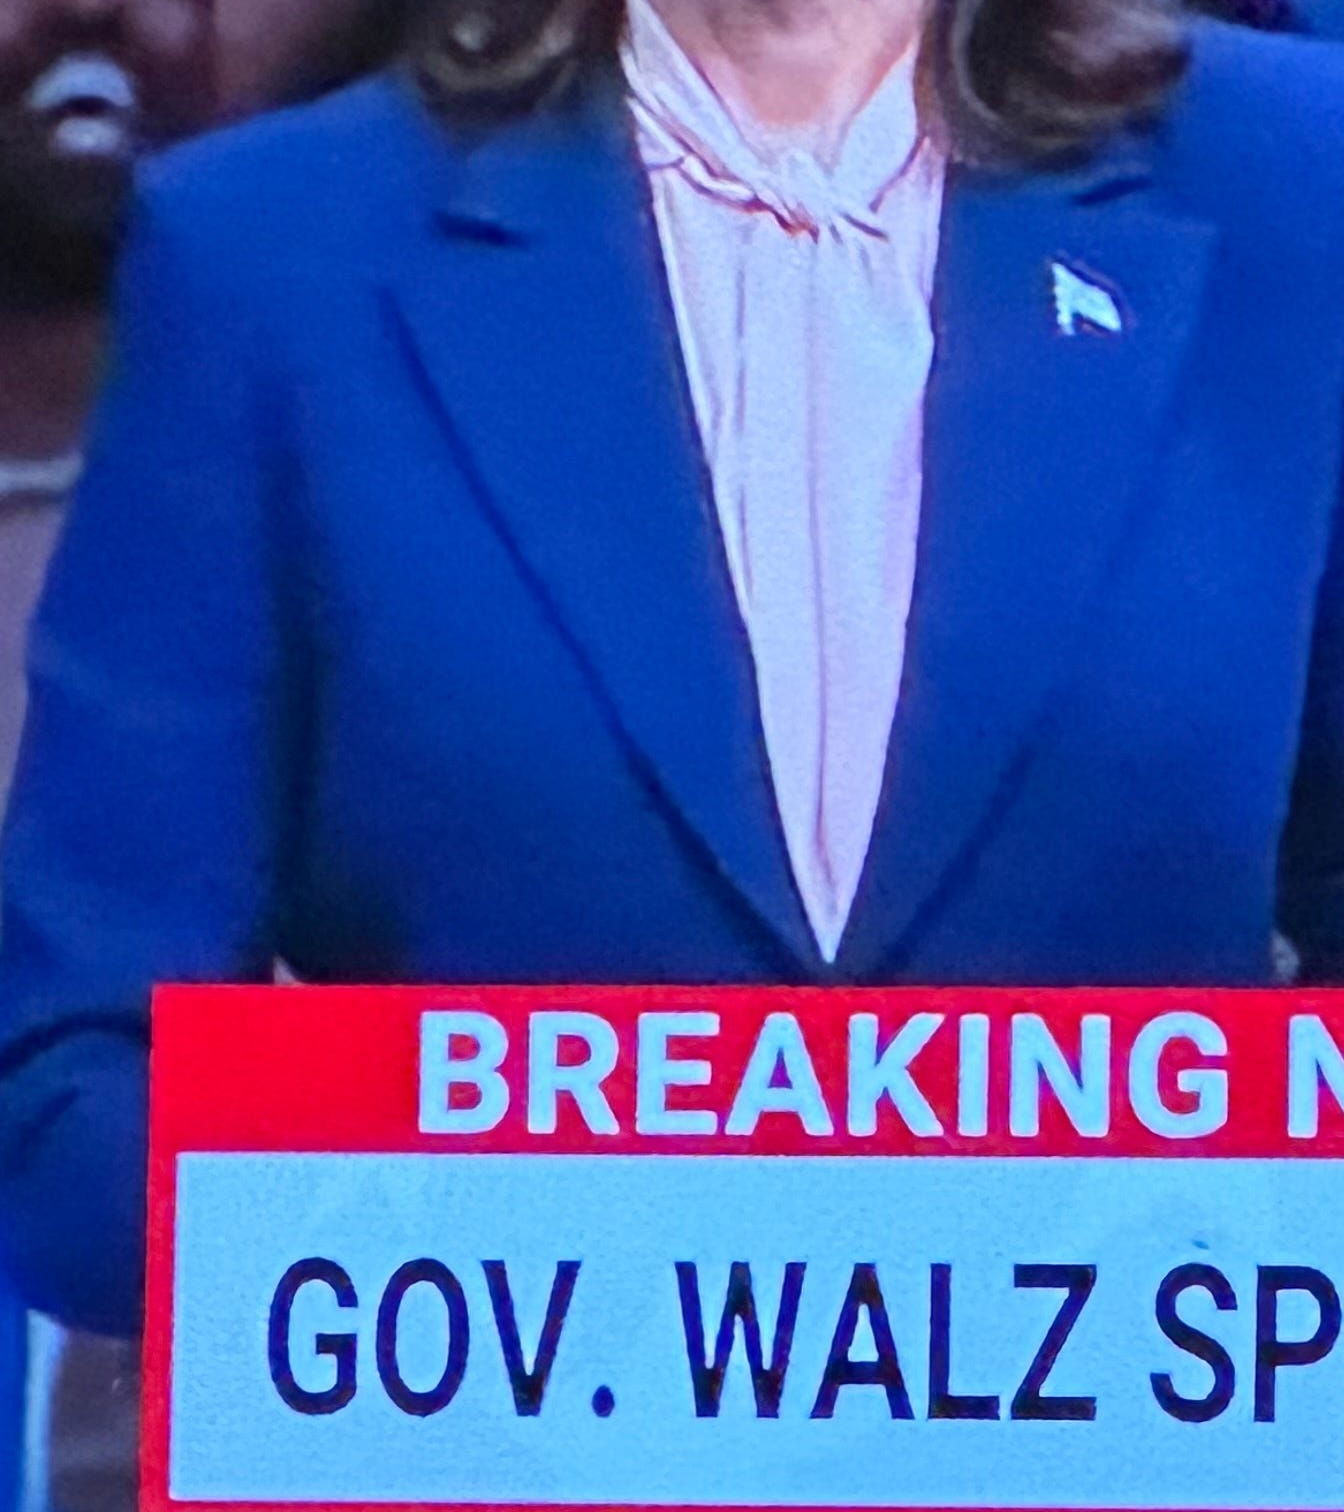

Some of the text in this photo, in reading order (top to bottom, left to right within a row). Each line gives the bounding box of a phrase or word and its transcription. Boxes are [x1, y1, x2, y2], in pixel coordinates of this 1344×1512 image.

[417, 1009, 1229, 1141] BREAKING
[267, 1256, 616, 1417] GOV.
[673, 1260, 1098, 1421] WALZ
